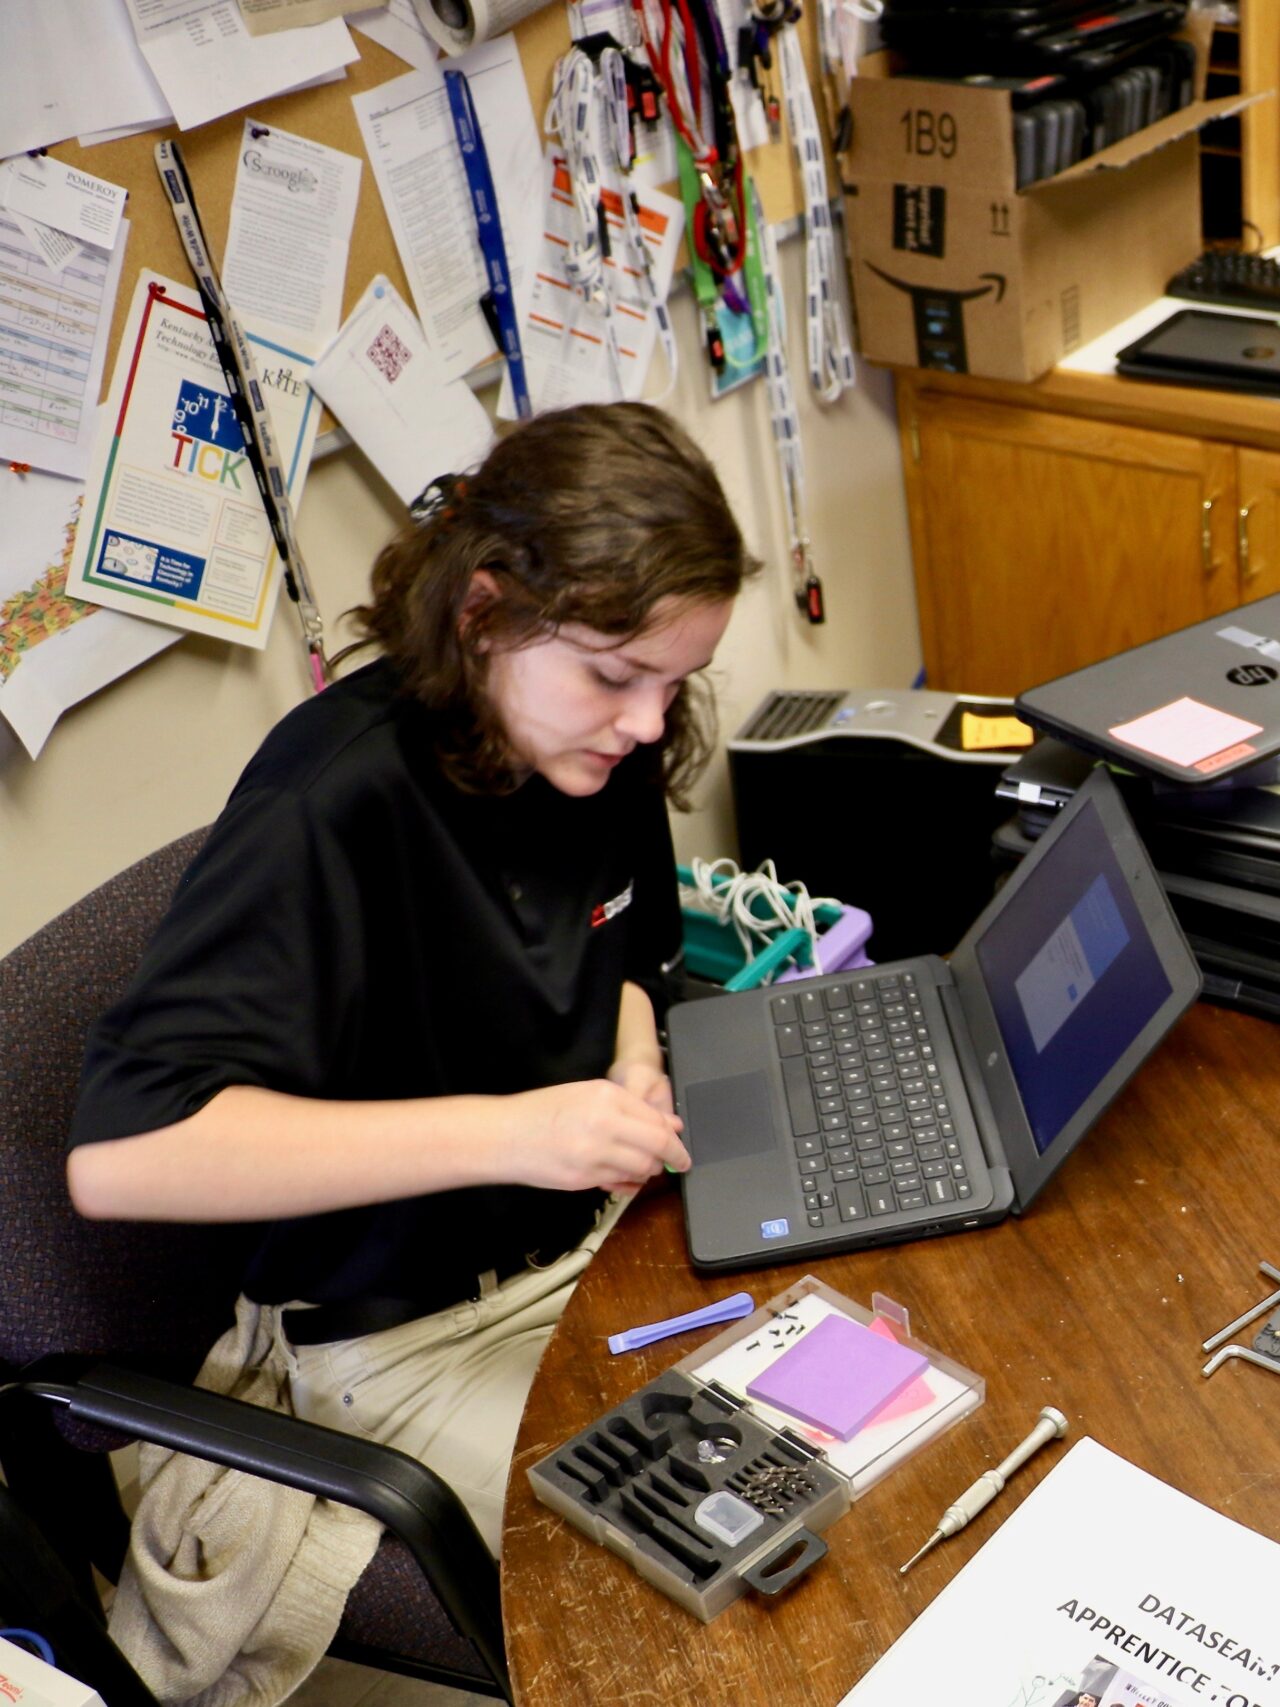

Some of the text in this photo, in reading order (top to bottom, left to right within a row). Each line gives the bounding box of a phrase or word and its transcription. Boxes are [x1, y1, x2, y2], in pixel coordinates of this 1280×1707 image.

[899, 107, 958, 160] 1B9
[67, 172, 117, 198] POMEROY
[171, 431, 247, 490] TICK
[1231, 664, 1276, 686] hp
[1056, 1598, 1212, 1694] APPRENTICE
